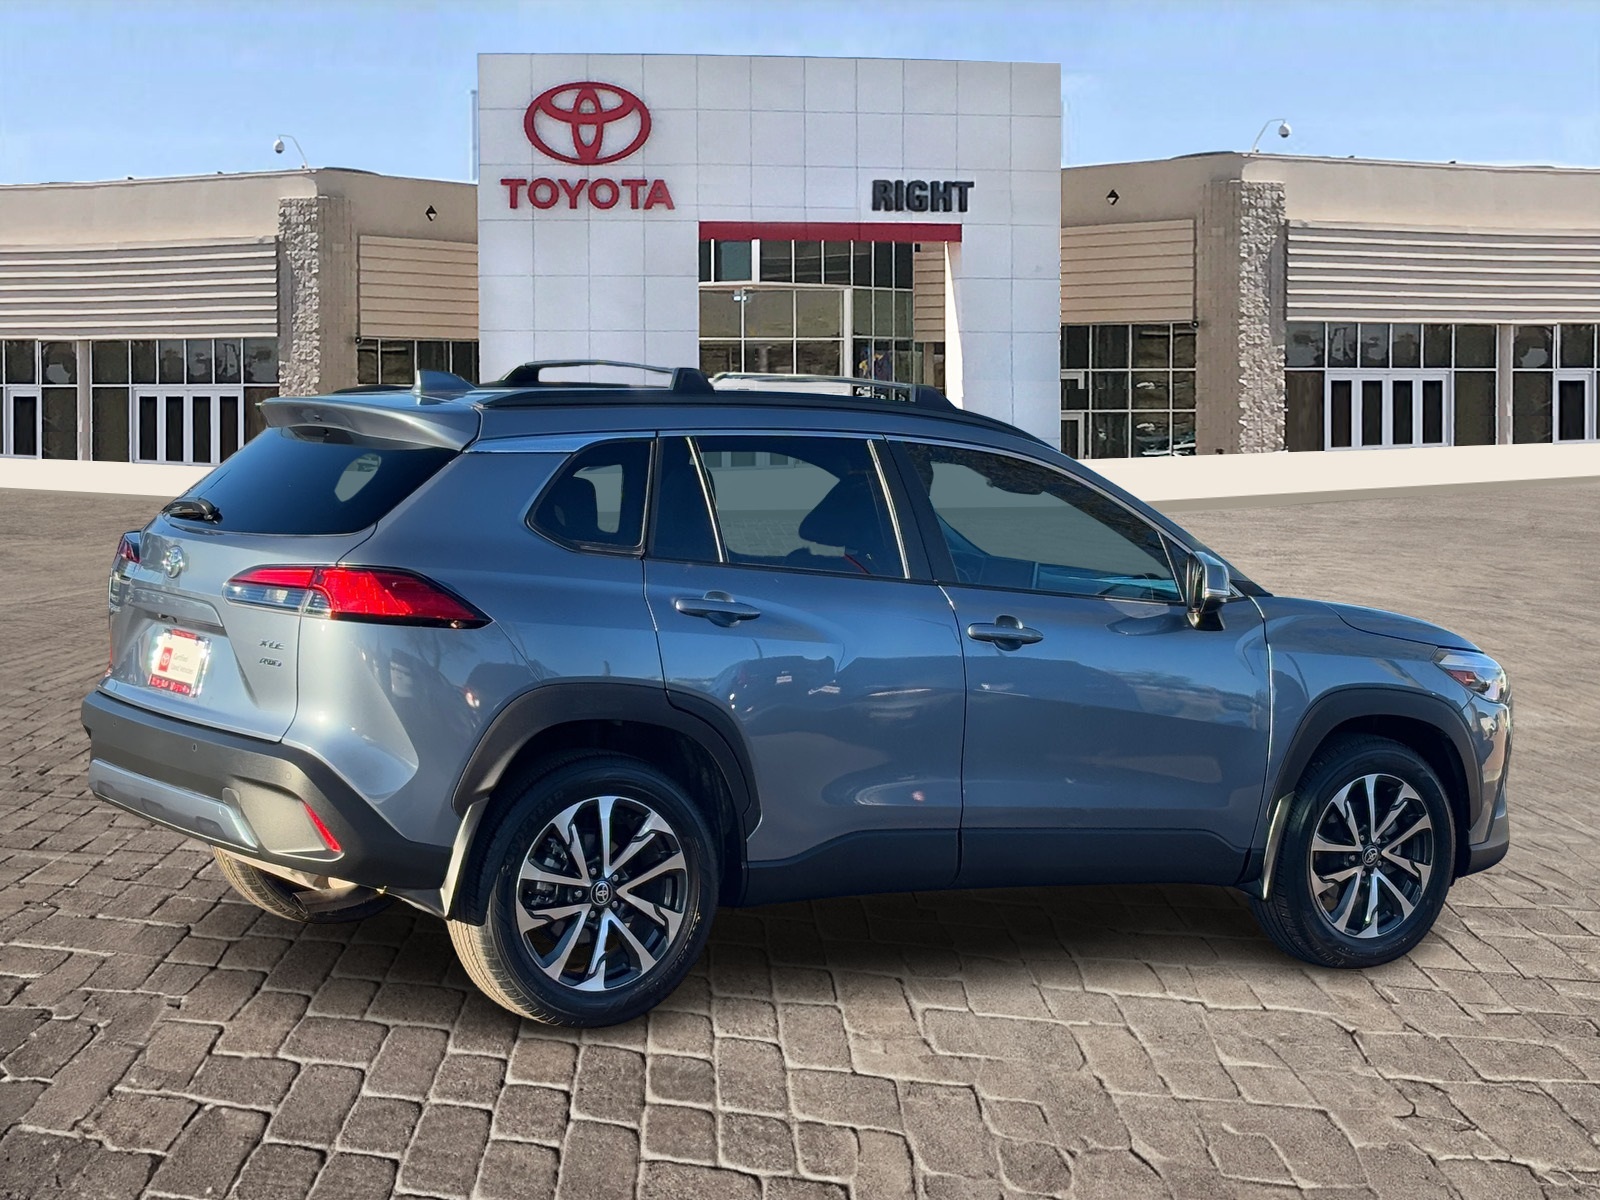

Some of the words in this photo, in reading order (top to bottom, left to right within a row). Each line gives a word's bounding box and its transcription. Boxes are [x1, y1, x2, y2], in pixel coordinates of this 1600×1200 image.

[500, 178, 675, 210] TOYOTA
[872, 179, 975, 212] RIGHT
[259, 639, 284, 650] XLE
